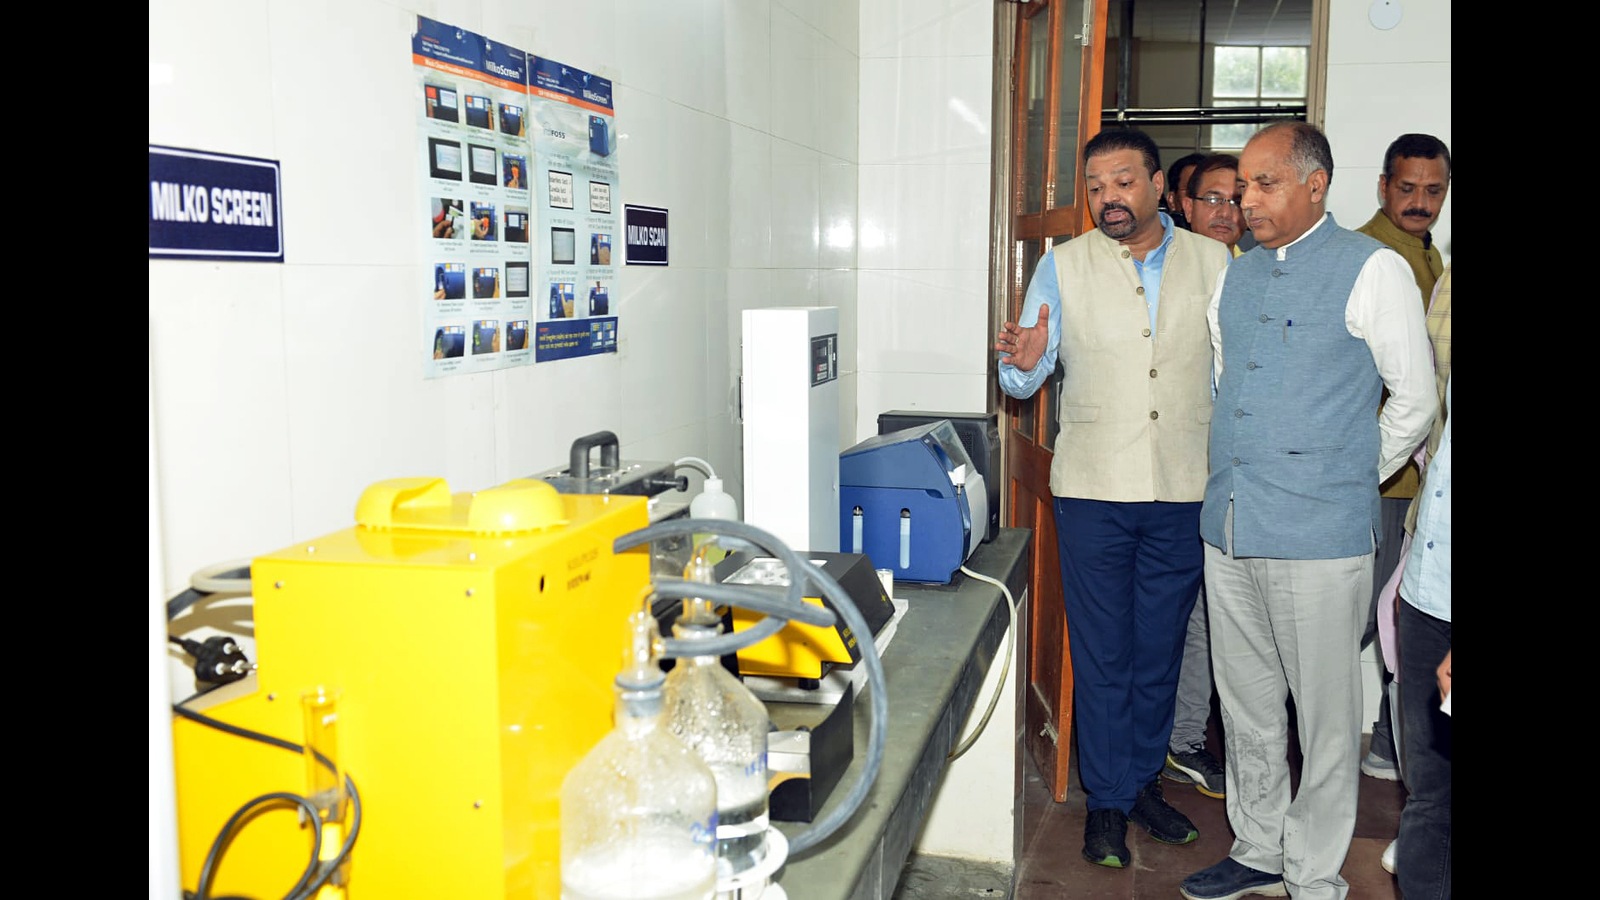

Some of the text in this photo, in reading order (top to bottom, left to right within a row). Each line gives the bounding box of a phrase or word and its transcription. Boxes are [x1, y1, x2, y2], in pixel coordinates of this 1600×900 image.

[551, 130, 566, 139] FOSS
[151, 181, 273, 227] MILKO SCREEN
[628, 225, 666, 247] MILKO SCAN
